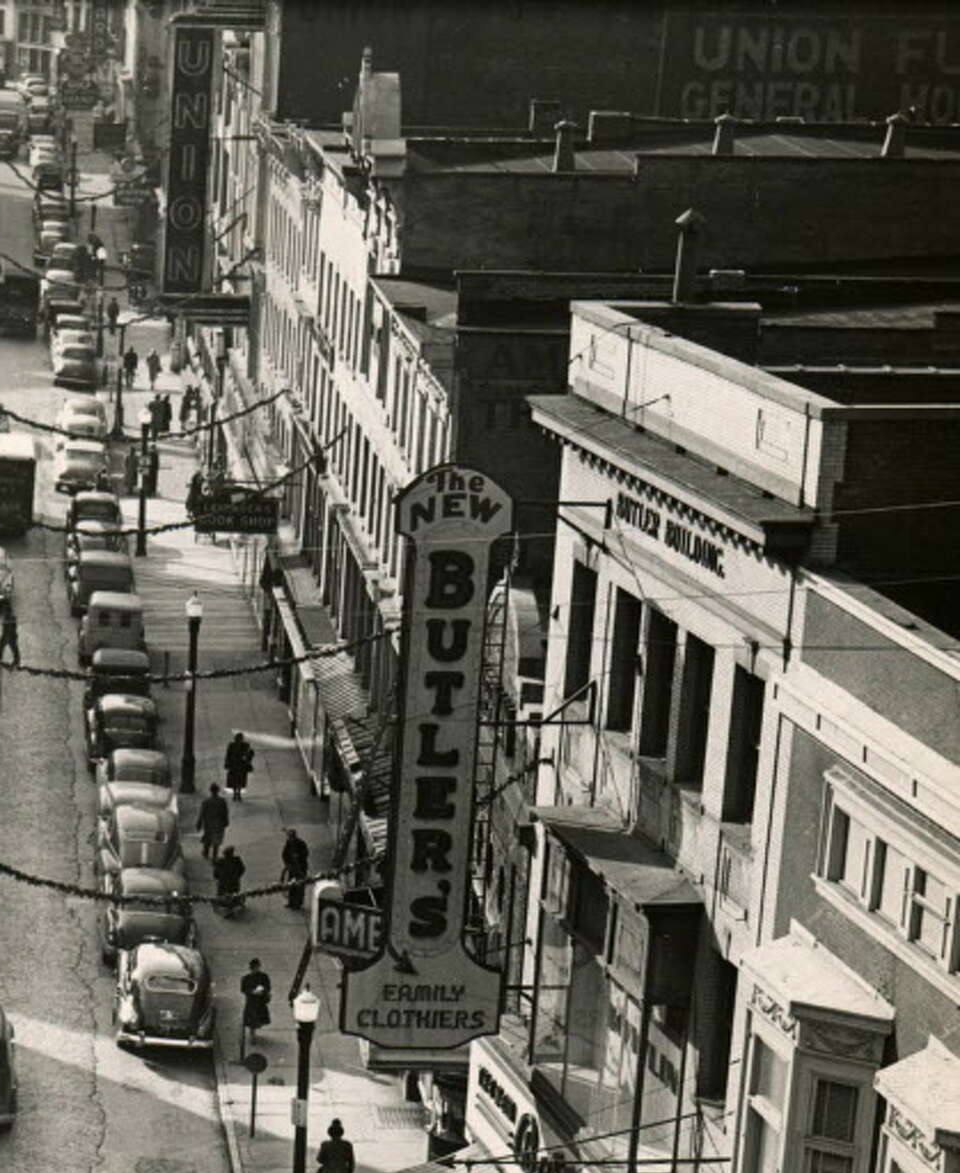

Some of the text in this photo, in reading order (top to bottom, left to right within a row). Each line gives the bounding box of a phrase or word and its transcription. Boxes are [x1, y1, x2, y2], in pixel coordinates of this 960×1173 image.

[692, 27, 861, 75] UNION
[166, 40, 211, 282] UNION
[426, 471, 485, 493] The
[409, 493, 503, 532] NEW
[616, 491, 661, 540] BUTLER
[408, 550, 476, 939] BUTLER'S
[356, 1009, 486, 1030] CLOTHIERS
